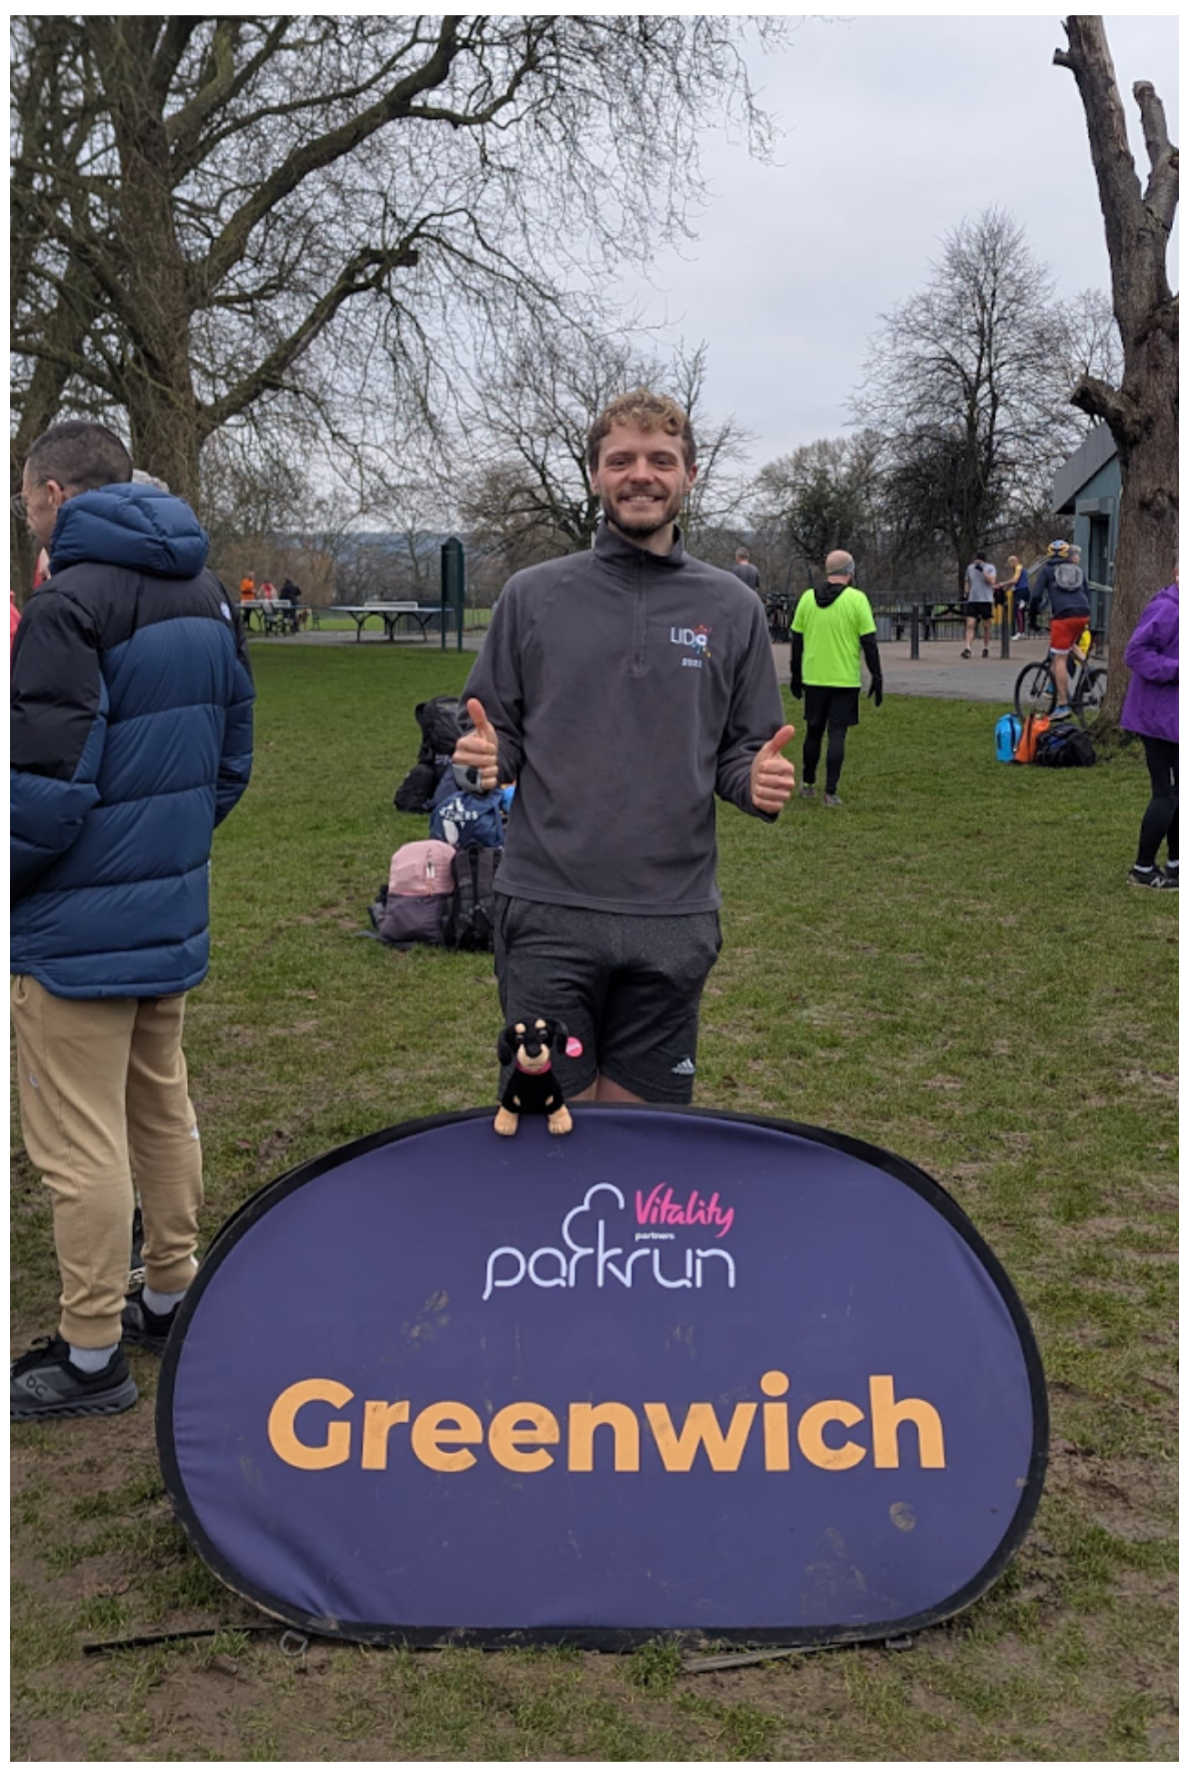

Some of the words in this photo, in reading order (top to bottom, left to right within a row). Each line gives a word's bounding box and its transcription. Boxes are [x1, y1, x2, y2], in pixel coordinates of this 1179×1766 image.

[634, 1231, 676, 1243] partners
[635, 1183, 734, 1238] Vitality
[482, 1219, 735, 1300] parkrun
[267, 1371, 945, 1472] Greenwich
